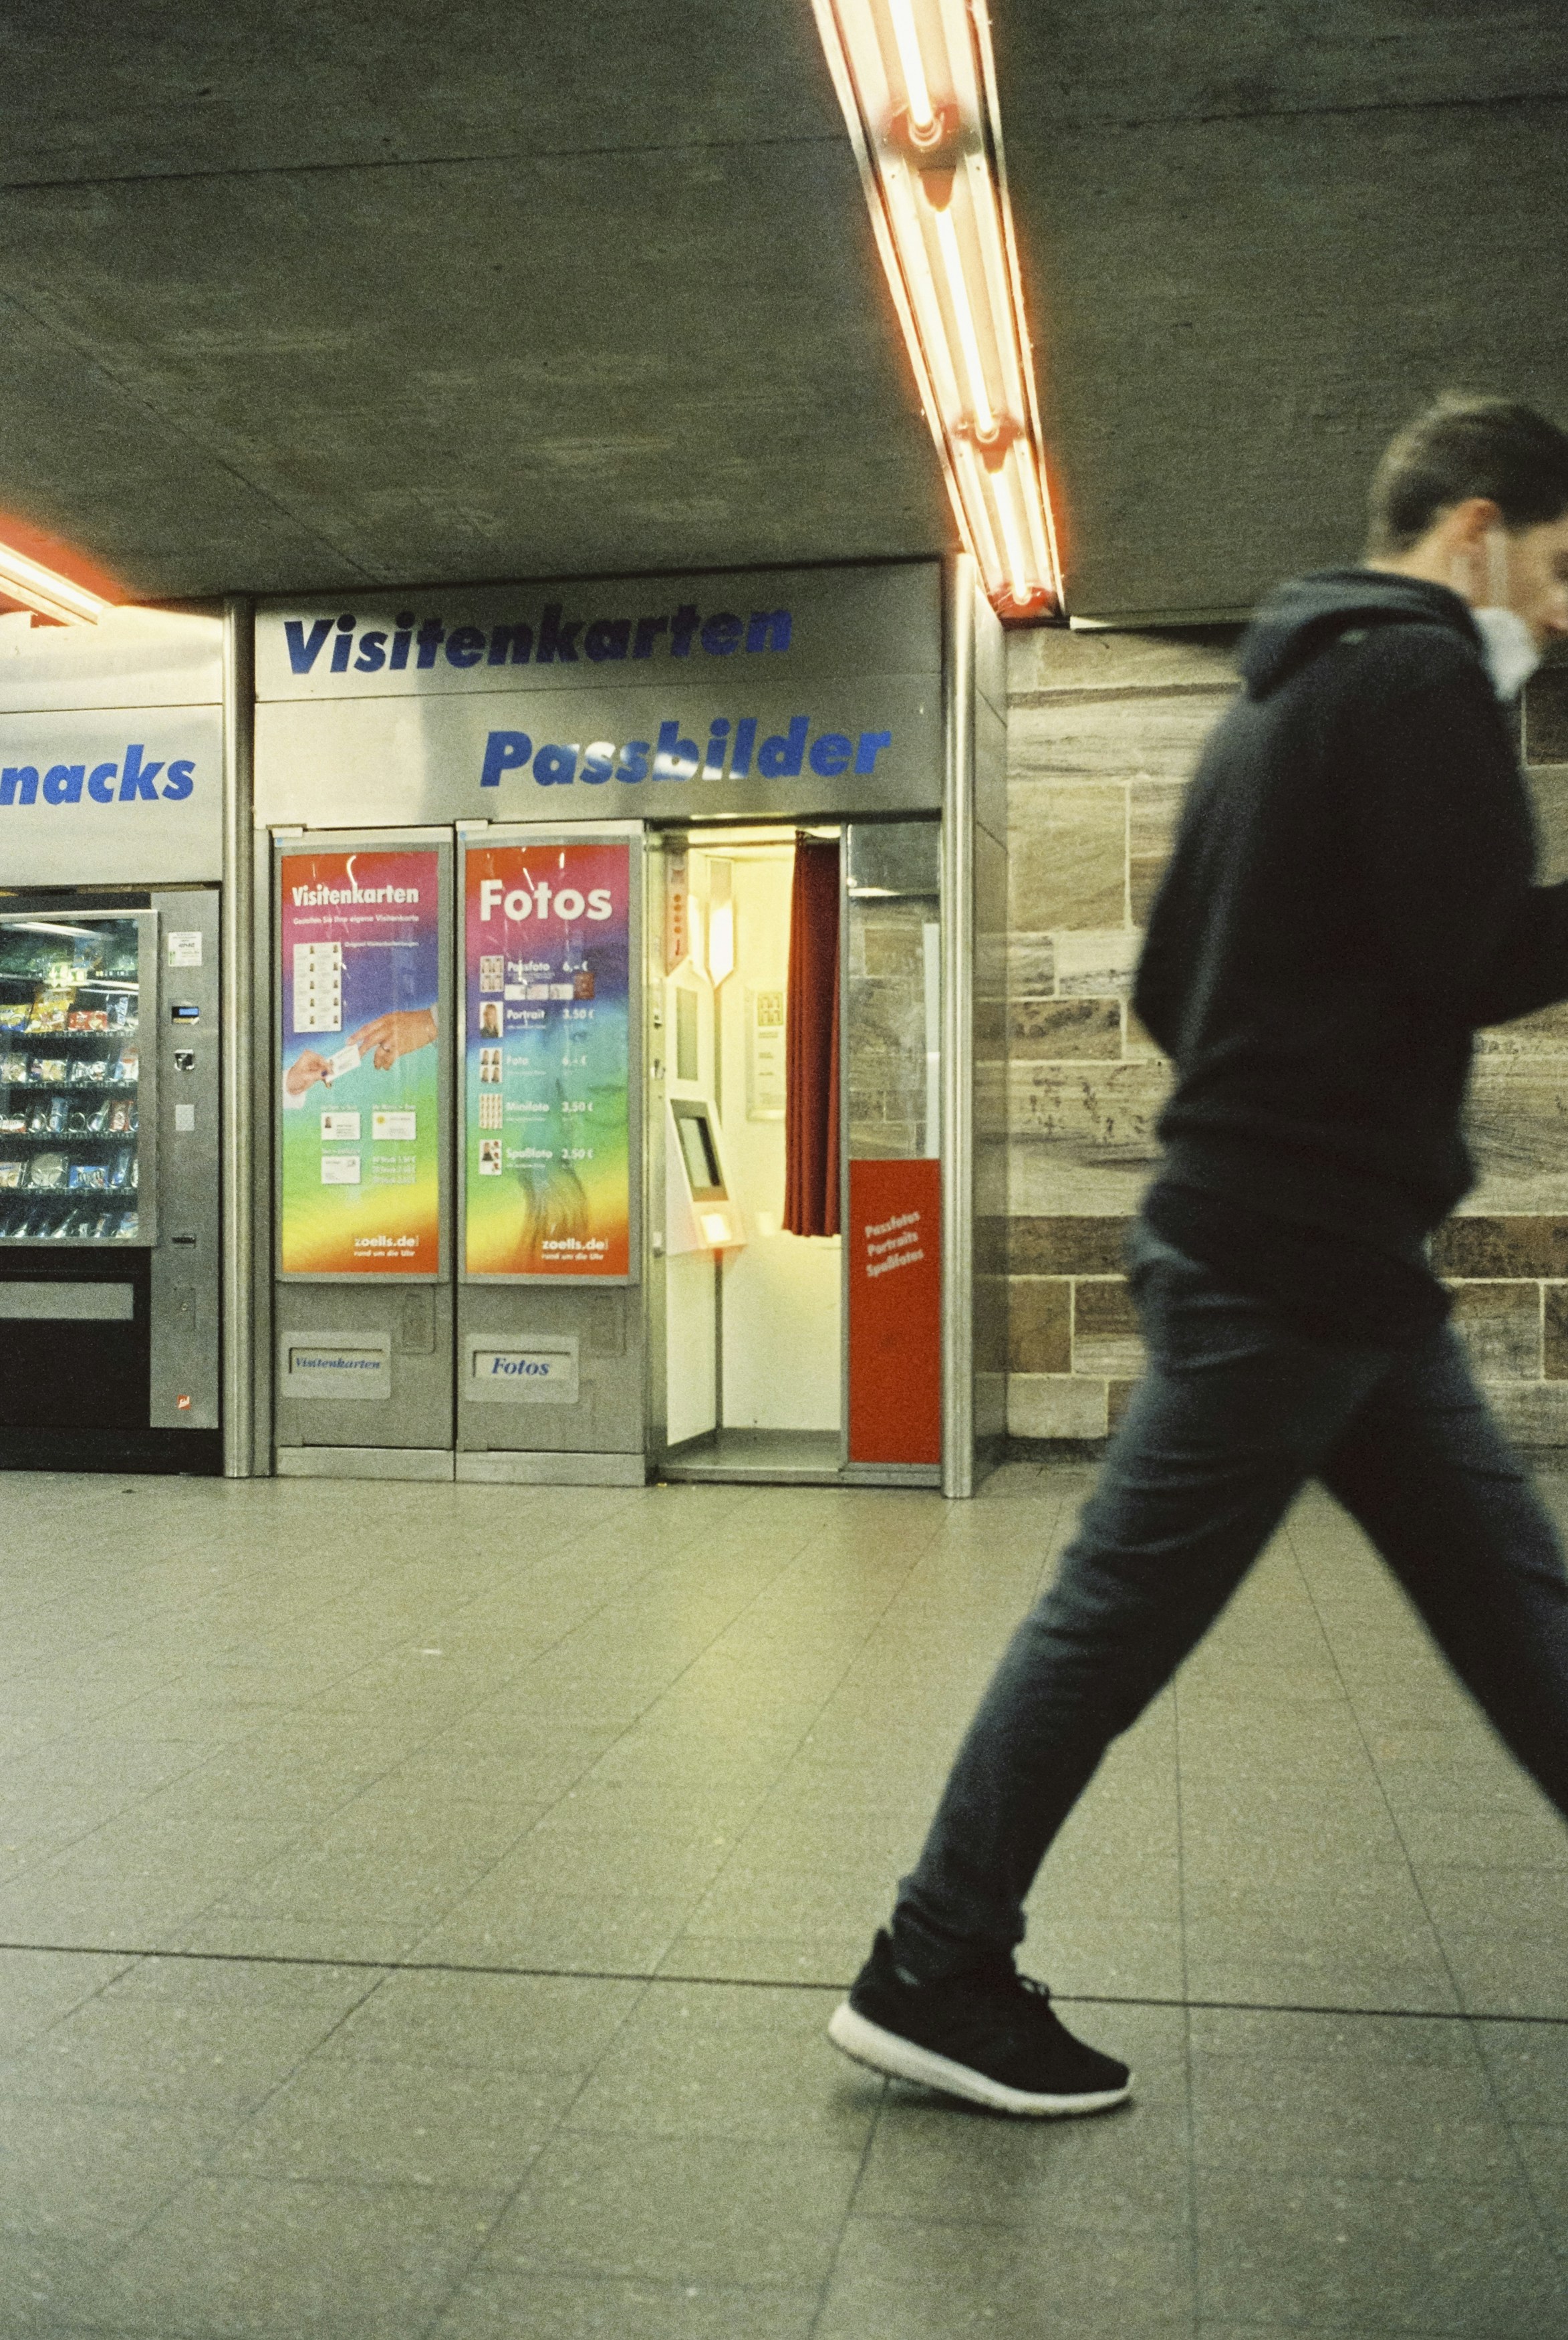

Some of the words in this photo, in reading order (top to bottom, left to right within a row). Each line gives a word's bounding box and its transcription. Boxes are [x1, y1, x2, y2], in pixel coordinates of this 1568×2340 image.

[283, 604, 793, 675] Visitenkarten
[480, 716, 891, 788] Passbilder
[0, 744, 197, 805] nacks
[292, 884, 420, 907] Visitenkarten
[480, 879, 613, 921] Fotos
[507, 1009, 545, 1020] Portrait
[295, 1356, 382, 1371] Visitenkarten
[491, 1357, 550, 1377] Fotos
